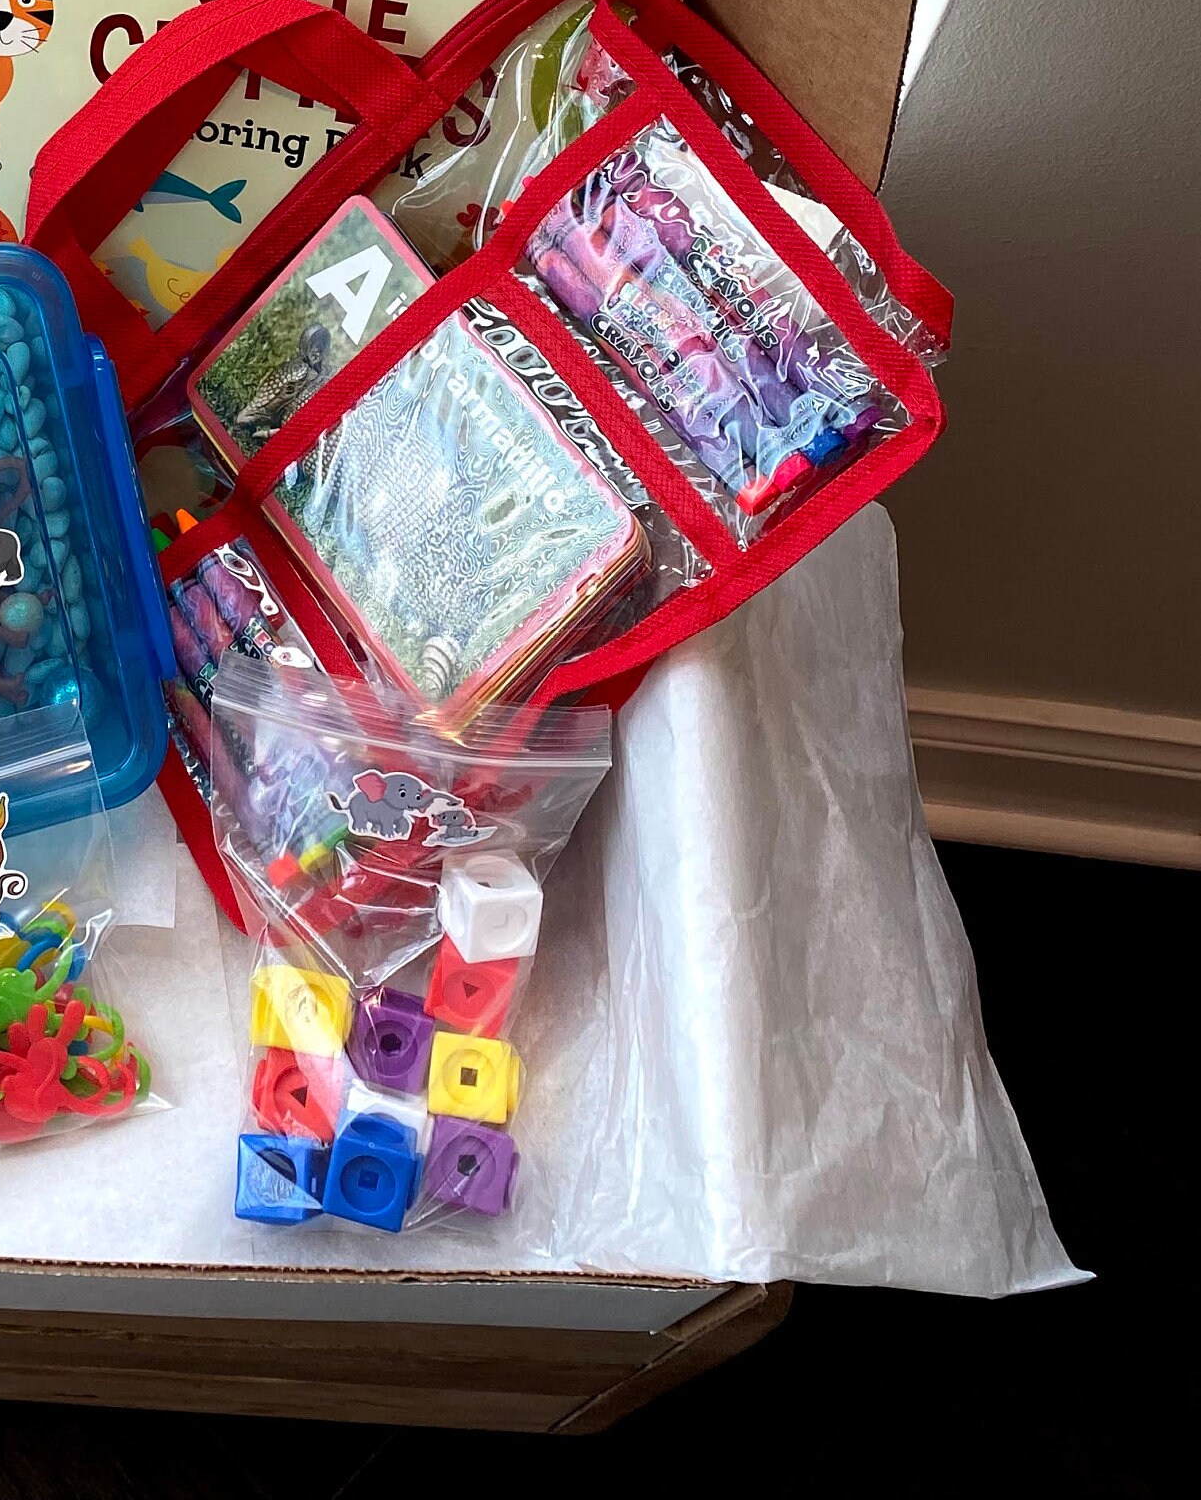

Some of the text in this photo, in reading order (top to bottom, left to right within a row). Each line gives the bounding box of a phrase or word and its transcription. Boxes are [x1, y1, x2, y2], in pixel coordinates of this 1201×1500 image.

[197, 119, 309, 168] oring
[657, 265, 746, 362] CRAYONS
[686, 251, 778, 349] CRAYONS
[305, 244, 393, 345] A
[446, 373, 566, 513] armadillo
[591, 313, 679, 412] CRAYONS
